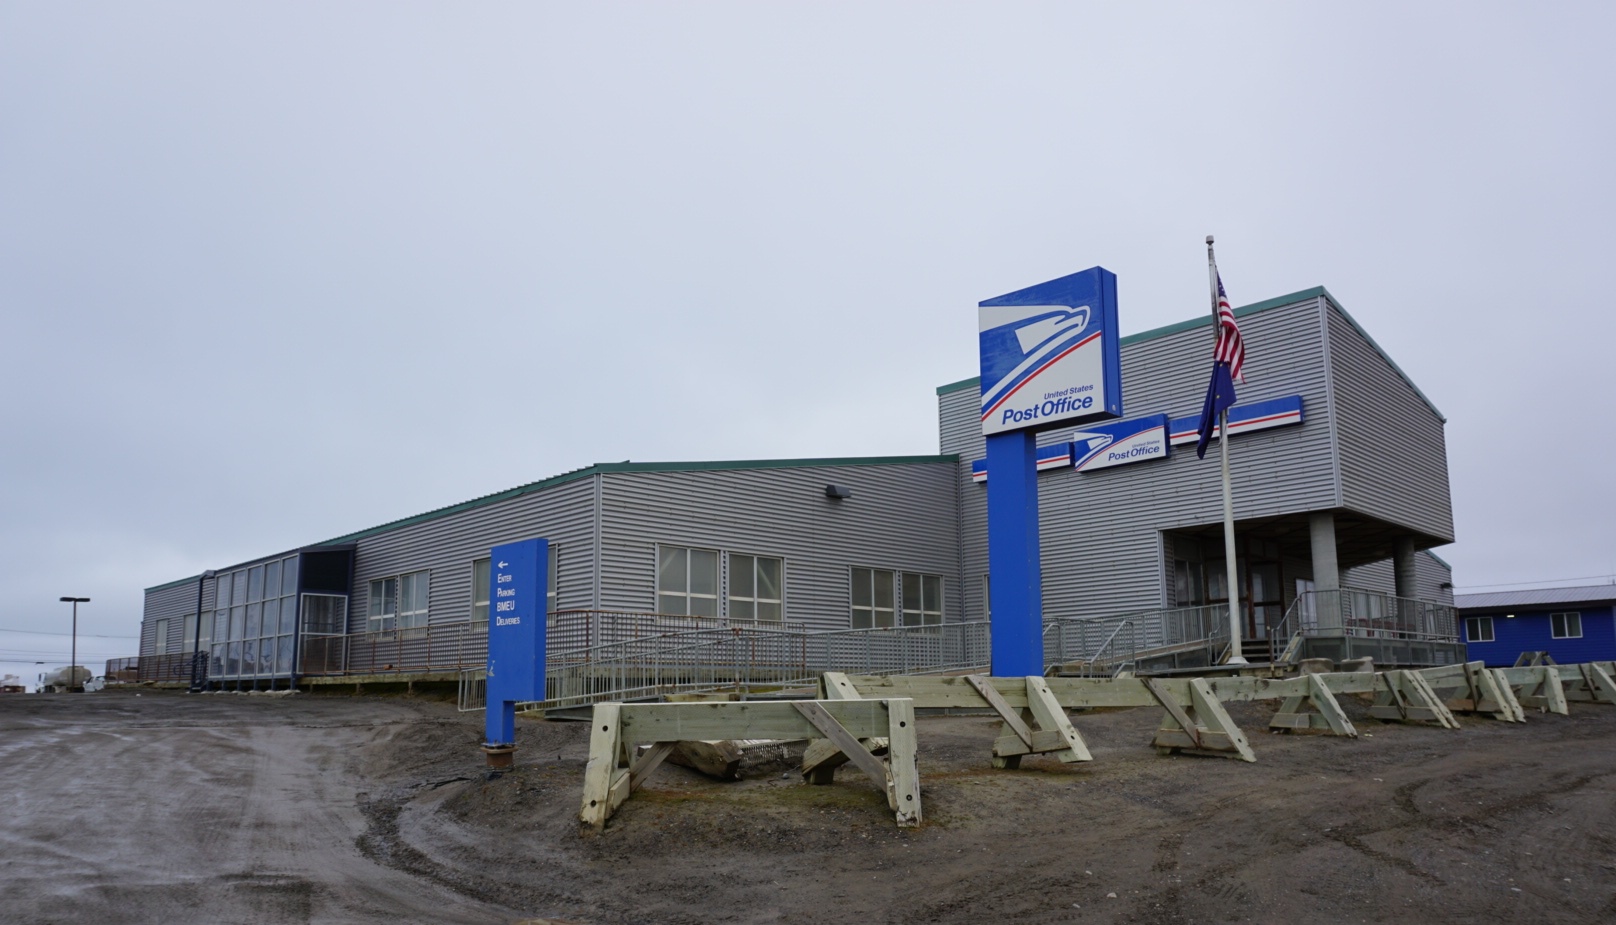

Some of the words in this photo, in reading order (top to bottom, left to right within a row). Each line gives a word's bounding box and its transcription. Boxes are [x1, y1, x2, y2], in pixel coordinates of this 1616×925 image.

[1043, 390, 1069, 400] United
[1069, 384, 1094, 395] States
[1002, 404, 1040, 425] Post
[1041, 395, 1093, 416] Office
[1108, 449, 1130, 461] Post
[1130, 445, 1160, 457] Office
[496, 600, 515, 612] BMEU
